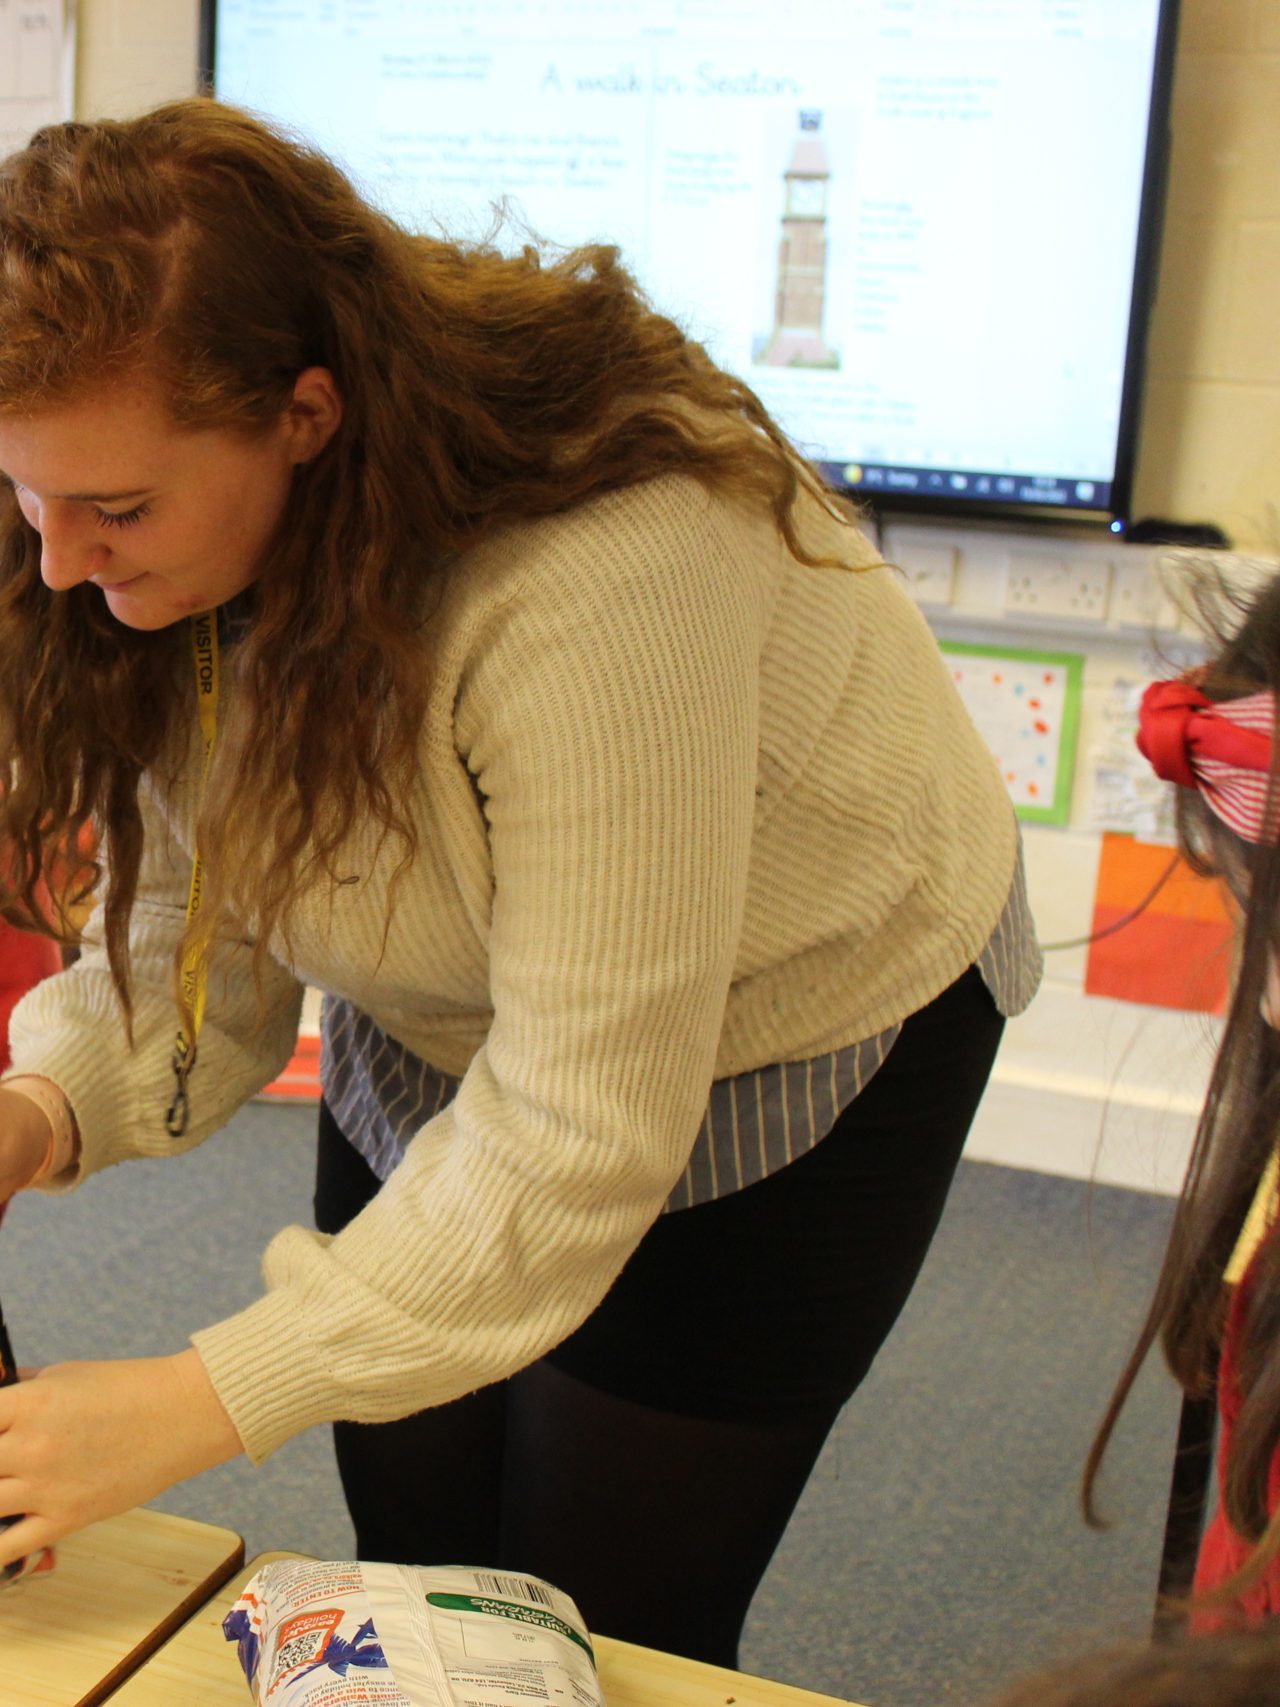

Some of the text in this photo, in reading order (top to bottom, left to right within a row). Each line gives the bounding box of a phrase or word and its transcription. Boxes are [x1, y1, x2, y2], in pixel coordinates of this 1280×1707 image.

[196, 615, 213, 695] VISITOR
[480, 1606, 567, 1636] SUITABLE FOR
